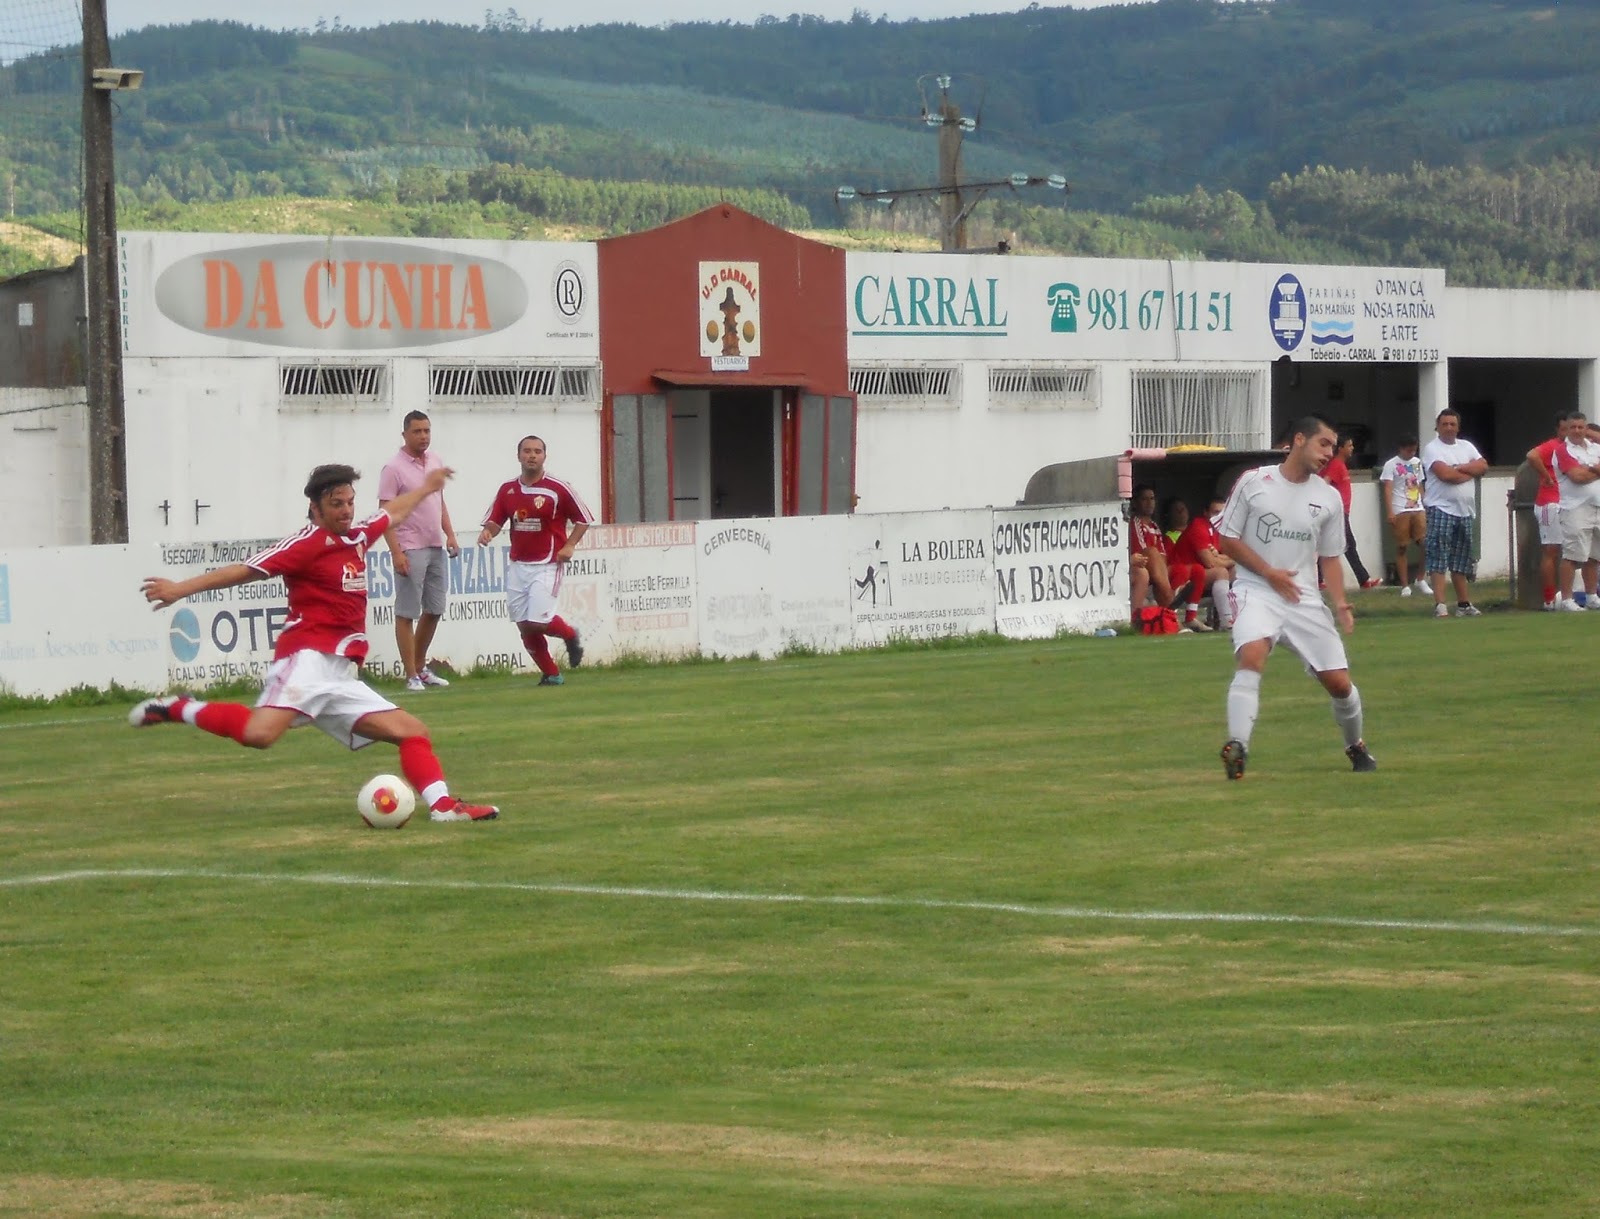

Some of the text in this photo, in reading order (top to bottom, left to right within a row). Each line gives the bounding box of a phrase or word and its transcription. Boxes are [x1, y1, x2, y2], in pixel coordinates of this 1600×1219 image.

[720, 267, 757, 301] CARRAL
[1375, 279, 1384, 296] O
[1386, 279, 1407, 296] PAN
[120, 236, 129, 352] PANADERIA
[202, 259, 492, 330] DA CUNHA
[854, 275, 1233, 332] CARRAL 981 67 11 51
[1309, 303, 1323, 315] DAS
[1363, 302, 1394, 318] NOSA
[1382, 325, 1418, 341] E ARTE
[1310, 348, 1341, 360] Tabeaio
[1348, 349, 1377, 361] CARRAL
[1392, 349, 1405, 360] 981
[1407, 349, 1416, 360] 67
[1419, 349, 1428, 360] 15
[1429, 349, 1439, 360] 33
[595, 528, 608, 549] DE
[611, 527, 624, 548] LA
[626, 523, 693, 547] CONSTRUCCION
[996, 516, 1119, 556] CONSTRUCCIONES
[162, 547, 205, 566] ASESORIA
[902, 538, 985, 563] LA BOLERA
[1029, 559, 1120, 603] BASCOY
[228, 587, 234, 601] Y
[898, 609, 947, 620] HAMBURGUESAS
[948, 609, 953, 618] Y
[952, 606, 986, 617] BOCADILLOS
[909, 624, 923, 633] 981
[926, 623, 941, 632] 670
[942, 621, 958, 631] 649
